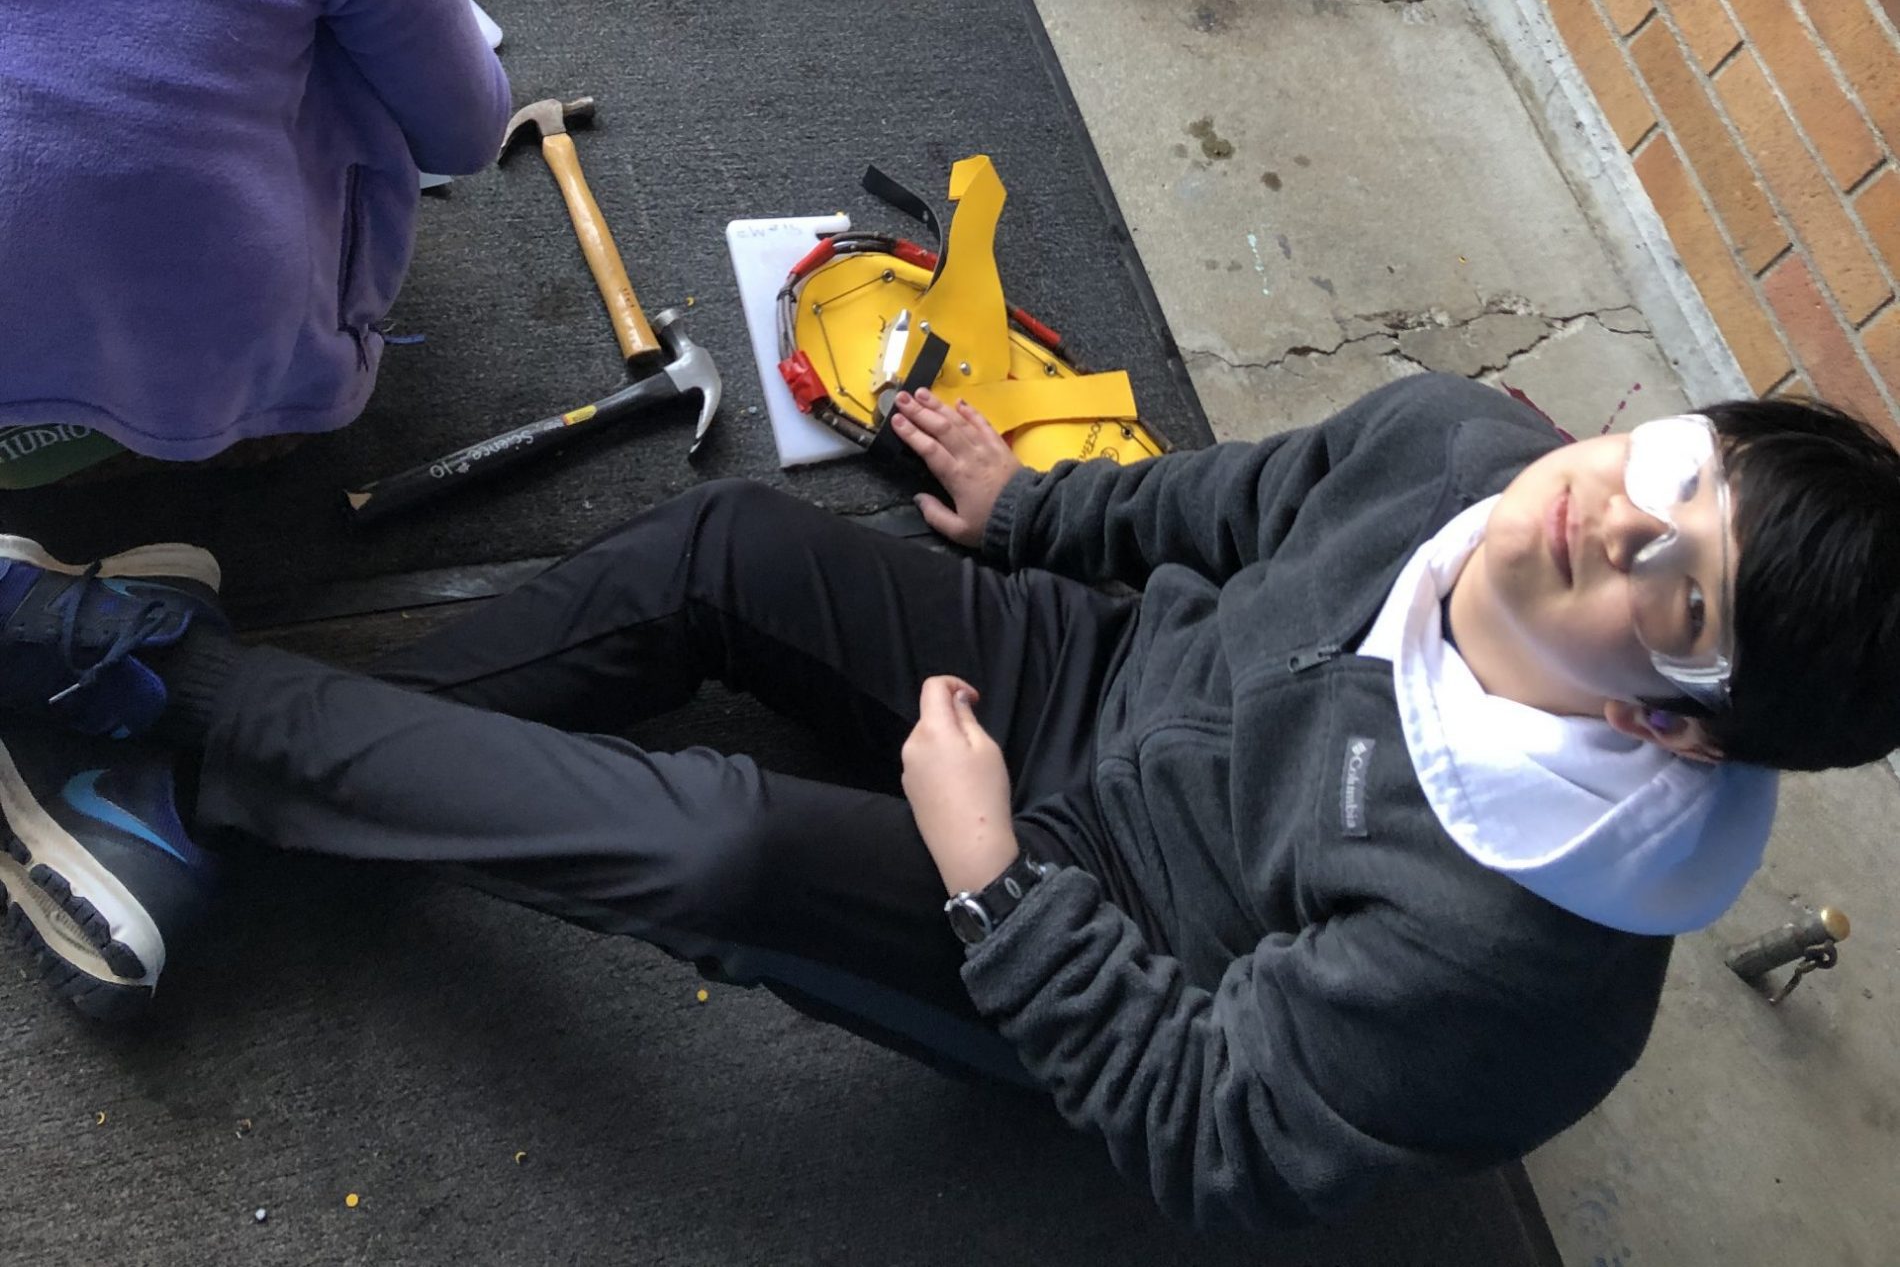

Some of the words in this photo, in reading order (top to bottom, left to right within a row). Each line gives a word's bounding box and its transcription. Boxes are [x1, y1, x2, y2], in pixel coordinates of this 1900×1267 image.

[0, 424, 91, 463] TUDIO
[467, 428, 535, 461] Science
[1344, 755, 1364, 829] Columbia
